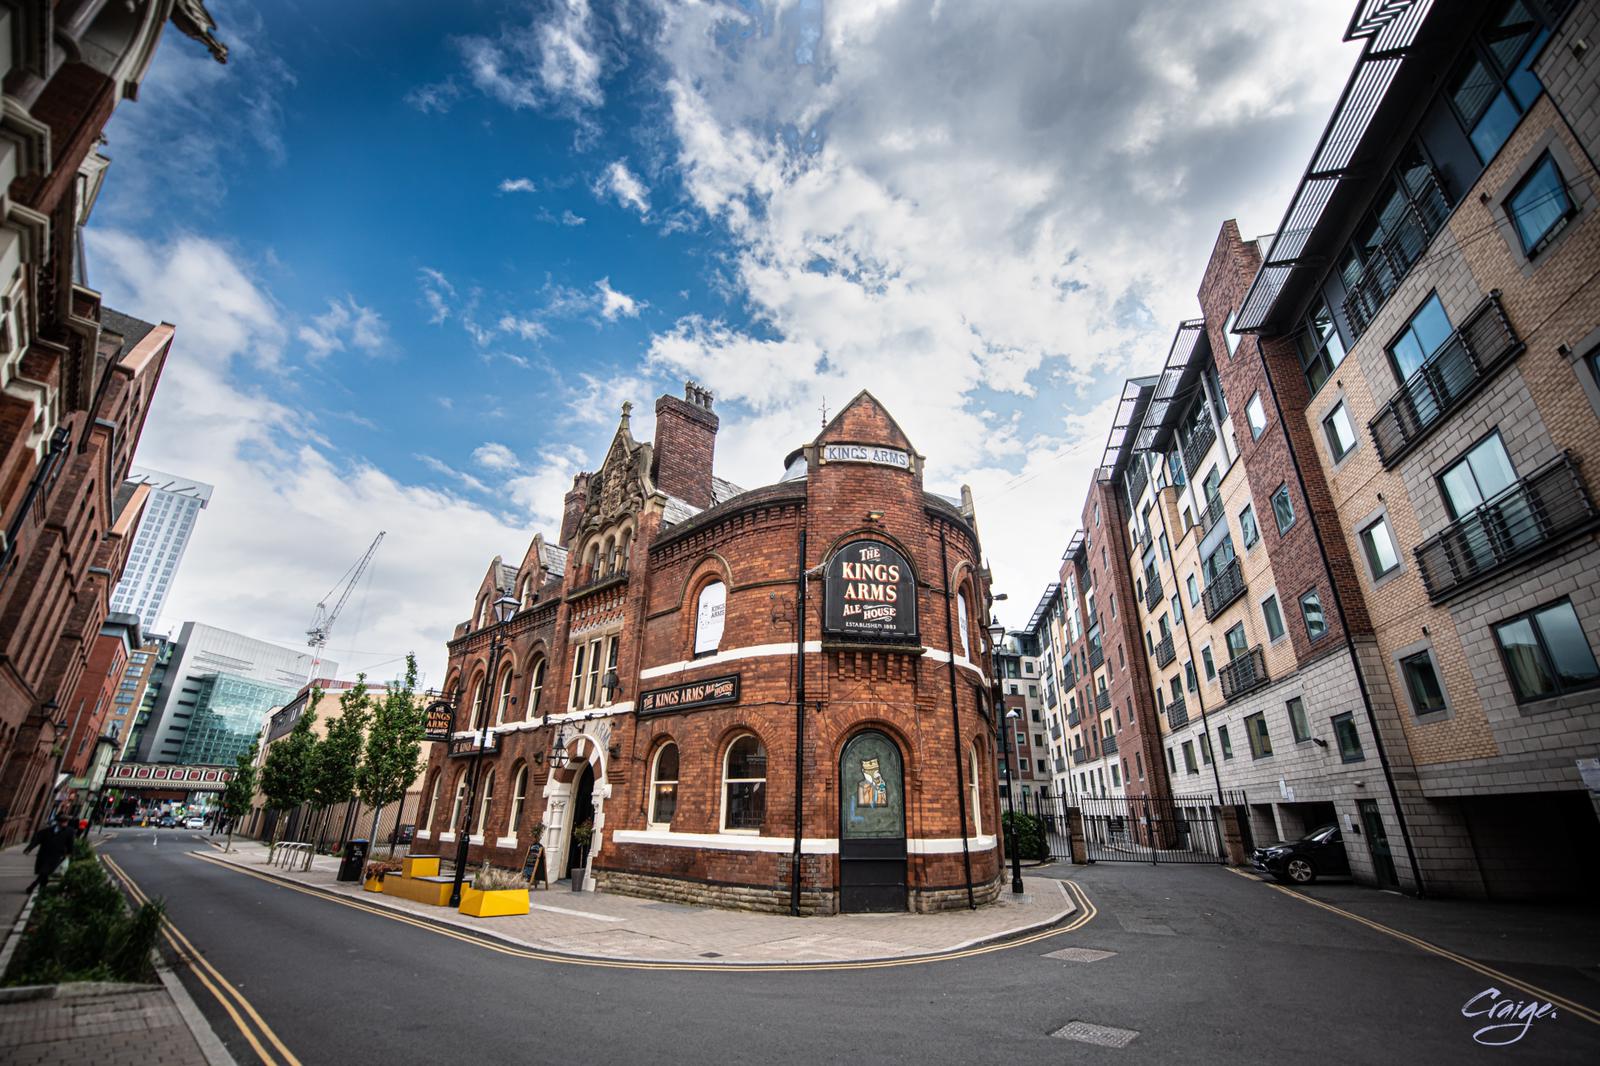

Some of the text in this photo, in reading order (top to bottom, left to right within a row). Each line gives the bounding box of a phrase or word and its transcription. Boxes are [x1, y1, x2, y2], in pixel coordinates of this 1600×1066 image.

[873, 449, 906, 466] ARMS
[859, 547, 881, 561] THE
[842, 561, 900, 583] KINGS
[843, 582, 898, 604] ARMS
[843, 604, 897, 620] ALE HOUSE
[655, 690, 680, 708] KINGS
[680, 685, 705, 703] ARMS
[704, 683, 716, 697] ALE
[714, 684, 734, 696] HOUSE
[427, 711, 451, 721] KINGS
[426, 720, 449, 729] ARMS
